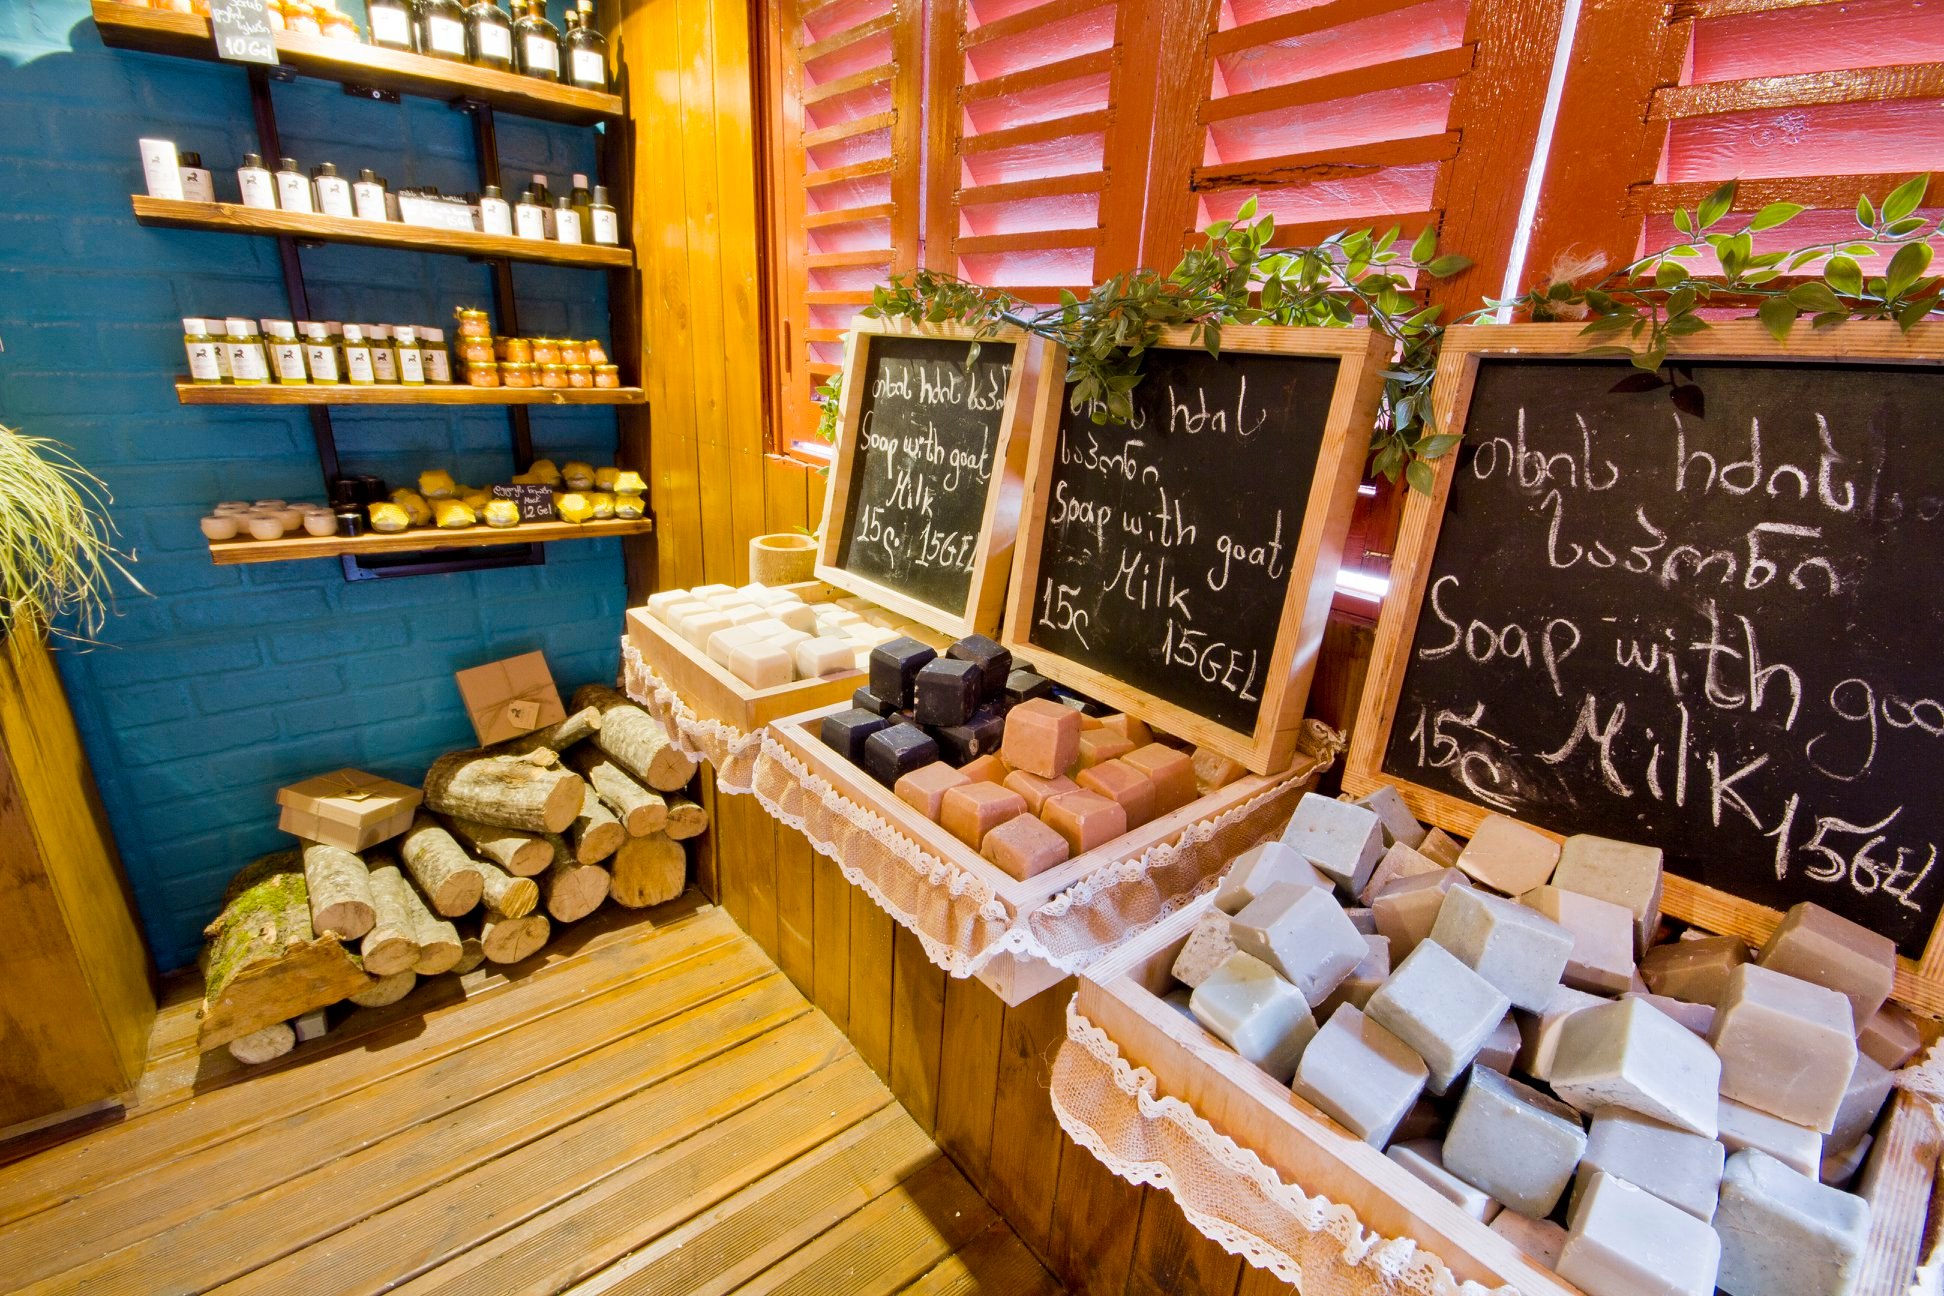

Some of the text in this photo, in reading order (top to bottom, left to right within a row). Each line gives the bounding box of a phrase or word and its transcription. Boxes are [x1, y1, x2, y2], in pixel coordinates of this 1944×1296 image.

[225, 37, 273, 60] 10 Gel
[872, 366, 912, 399] თხის
[861, 410, 991, 492] Soap with goat
[1062, 429, 1159, 485] საპონი
[1473, 407, 1619, 491] თხის
[523, 503, 552, 519] 12 Gel
[886, 470, 933, 520] Milk
[1051, 480, 1283, 592] Soap with goat
[1541, 489, 1840, 598] საპონი
[1103, 549, 1192, 621] Milk
[1162, 618, 1258, 702] 15GEL
[1419, 575, 1944, 782] Soap with goa
